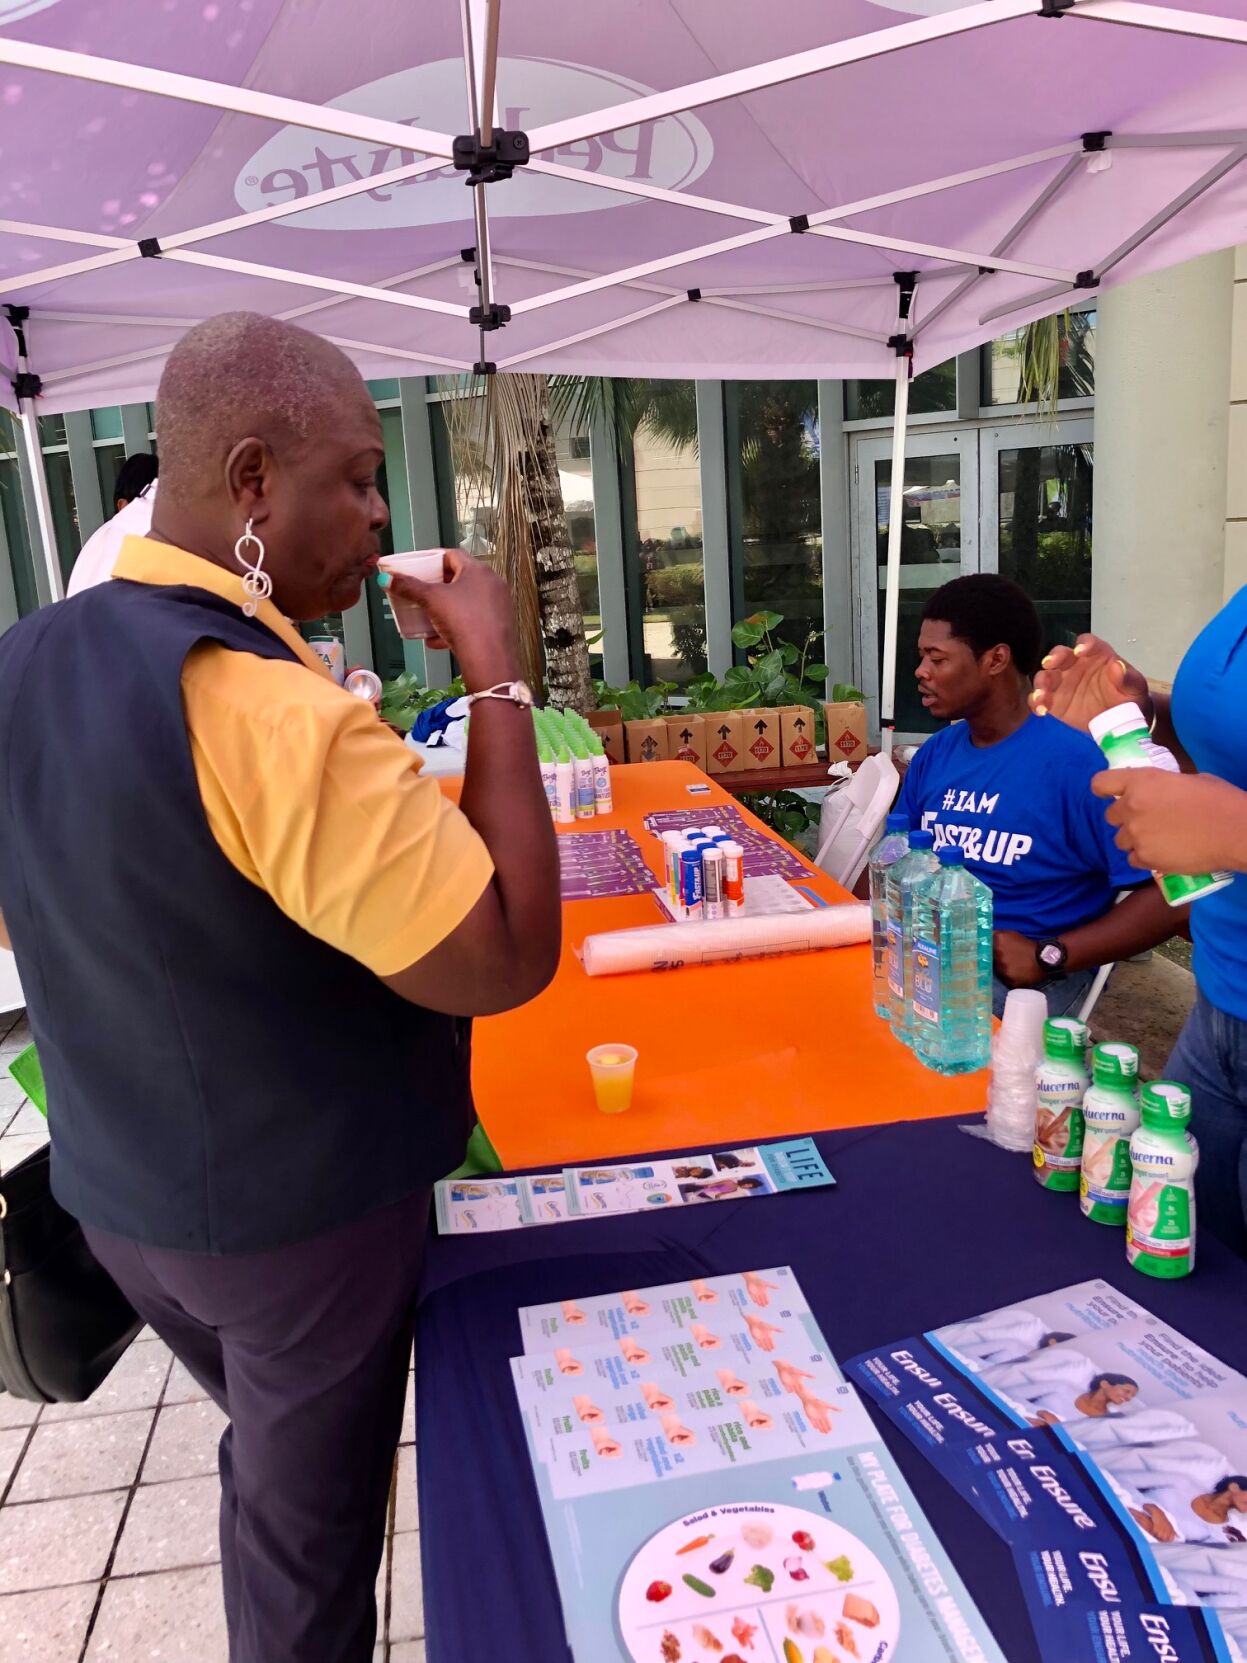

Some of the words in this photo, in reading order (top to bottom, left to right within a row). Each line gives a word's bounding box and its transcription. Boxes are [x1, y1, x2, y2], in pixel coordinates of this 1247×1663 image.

[1083, 1106, 1126, 1121] lucerna
[786, 1148, 824, 1180] LIFE
[1028, 1465, 1097, 1529] Ensure
[682, 1512, 709, 1527] Salad
[720, 1505, 775, 1514] Vegetables
[1040, 1550, 1055, 1574] YOUR
[1052, 1550, 1066, 1571] YOUR
[1098, 1610, 1113, 1636] YOUR
[1110, 1610, 1125, 1634] YOUR
[1116, 1634, 1131, 1658] LIFE.
